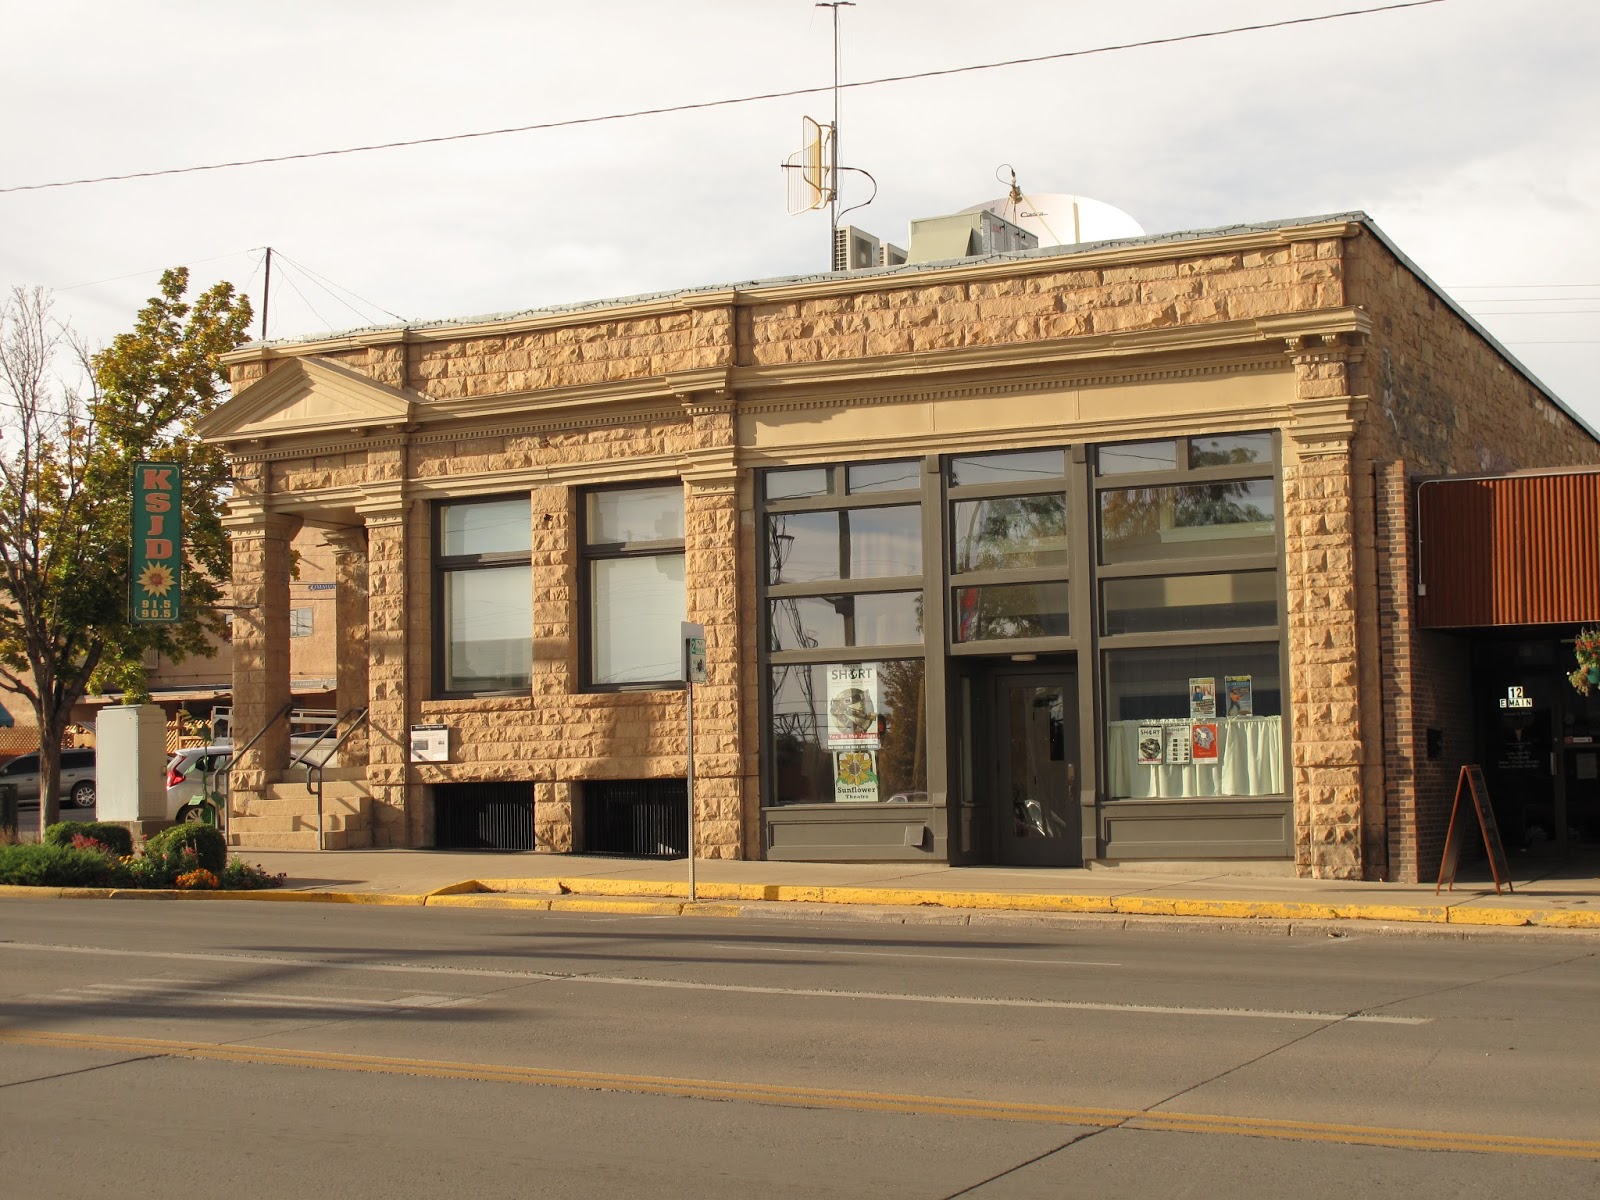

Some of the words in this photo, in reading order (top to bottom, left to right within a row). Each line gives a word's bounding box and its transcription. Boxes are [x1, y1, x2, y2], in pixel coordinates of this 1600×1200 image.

[143, 469, 173, 559] KSJD
[142, 600, 171, 609] 91.5
[141, 609, 171, 618] 90.5
[831, 668, 872, 680] SHORT
[1510, 687, 1522, 698] 12
[837, 786, 876, 794] Sunflower
